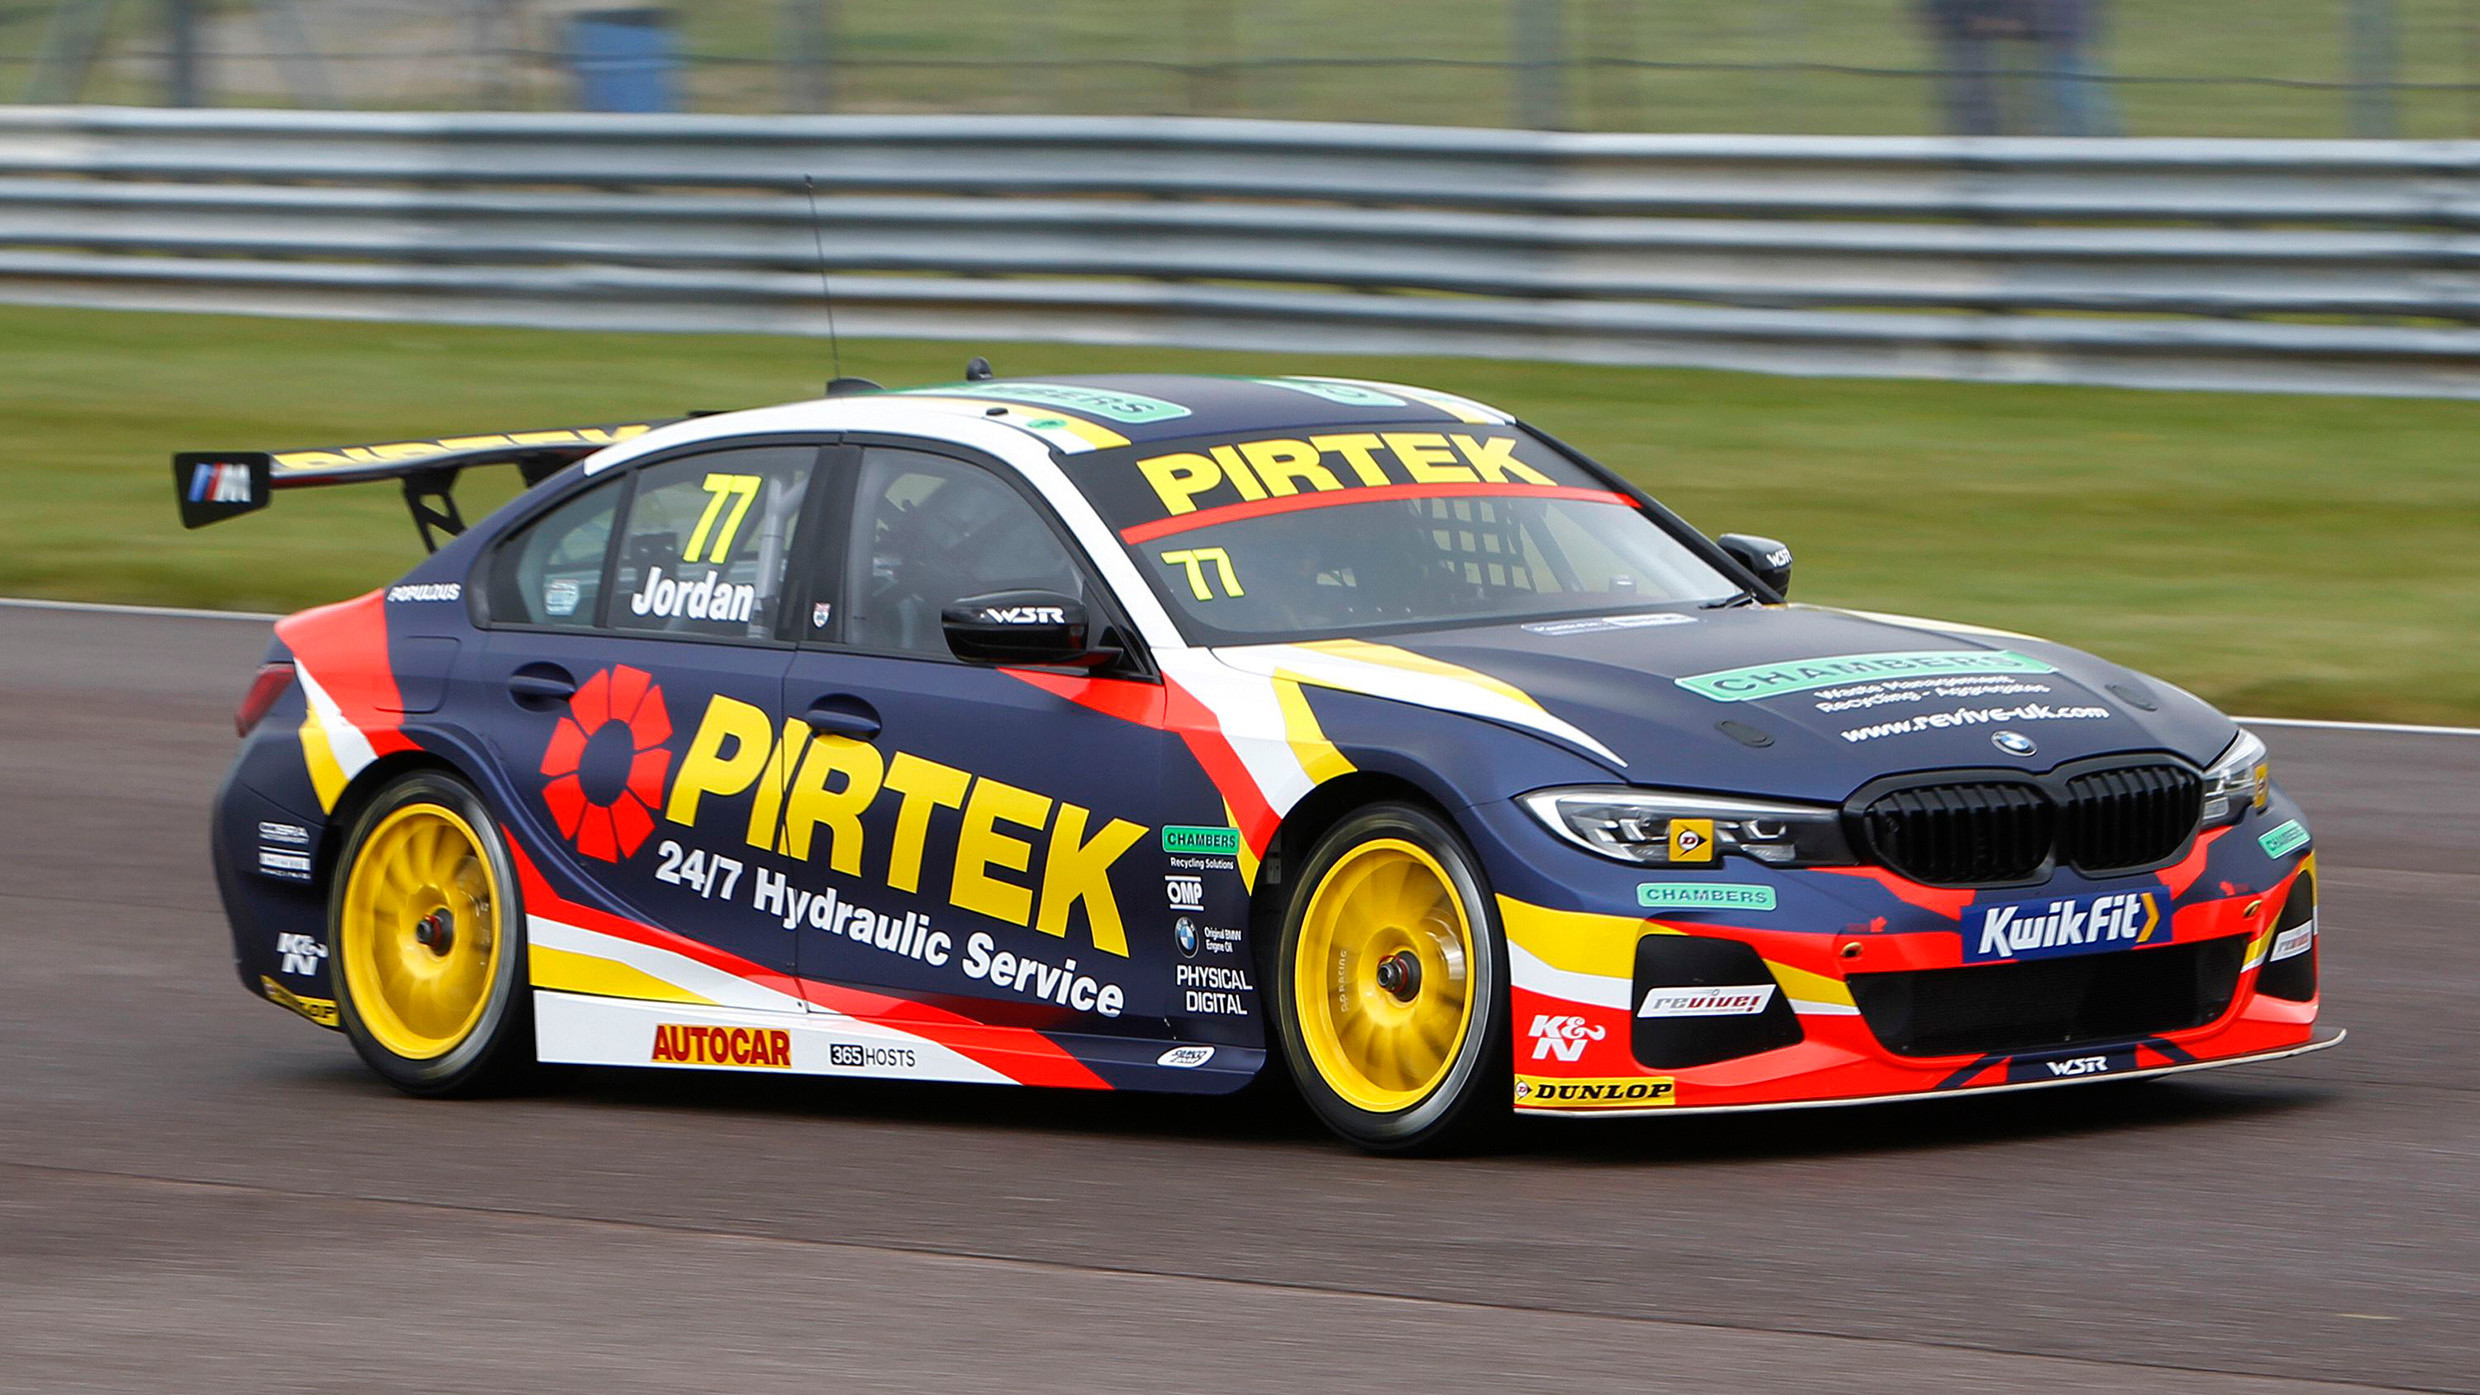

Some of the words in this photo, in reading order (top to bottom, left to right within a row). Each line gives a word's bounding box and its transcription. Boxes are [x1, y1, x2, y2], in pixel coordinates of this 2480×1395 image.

[1136, 433, 1558, 516] PIRTEK
[682, 472, 763, 565] 77
[1765, 548, 1793, 567] WSR
[1160, 546, 1246, 602] 77
[631, 566, 755, 622] Jordan
[986, 607, 1065, 624] WSR
[1712, 655, 2024, 694] CHAMBERS
[1841, 703, 2110, 742] www.revive-uk.com
[664, 693, 1150, 959] PIRTEK
[1168, 832, 1236, 848] CHAMBERS
[1170, 857, 1204, 870] Recycling
[1206, 858, 1234, 870] Solutions
[1167, 881, 1203, 904] OMP
[1646, 888, 1767, 903] CHAMBERS
[655, 840, 743, 900] 24/7
[753, 866, 951, 966] Hydraulic
[962, 932, 1125, 1018] Service
[1204, 926, 1224, 941] Original
[1225, 928, 1242, 941] BMW
[1206, 939, 1224, 953] Engine
[1176, 965, 1253, 990] PHYSICAL
[1186, 991, 1248, 1015] DIGITAL
[652, 1024, 792, 1066] AUTOCAR
[2046, 1056, 2108, 1075] WSR
[1535, 1083, 1672, 1100] DUNLOP
